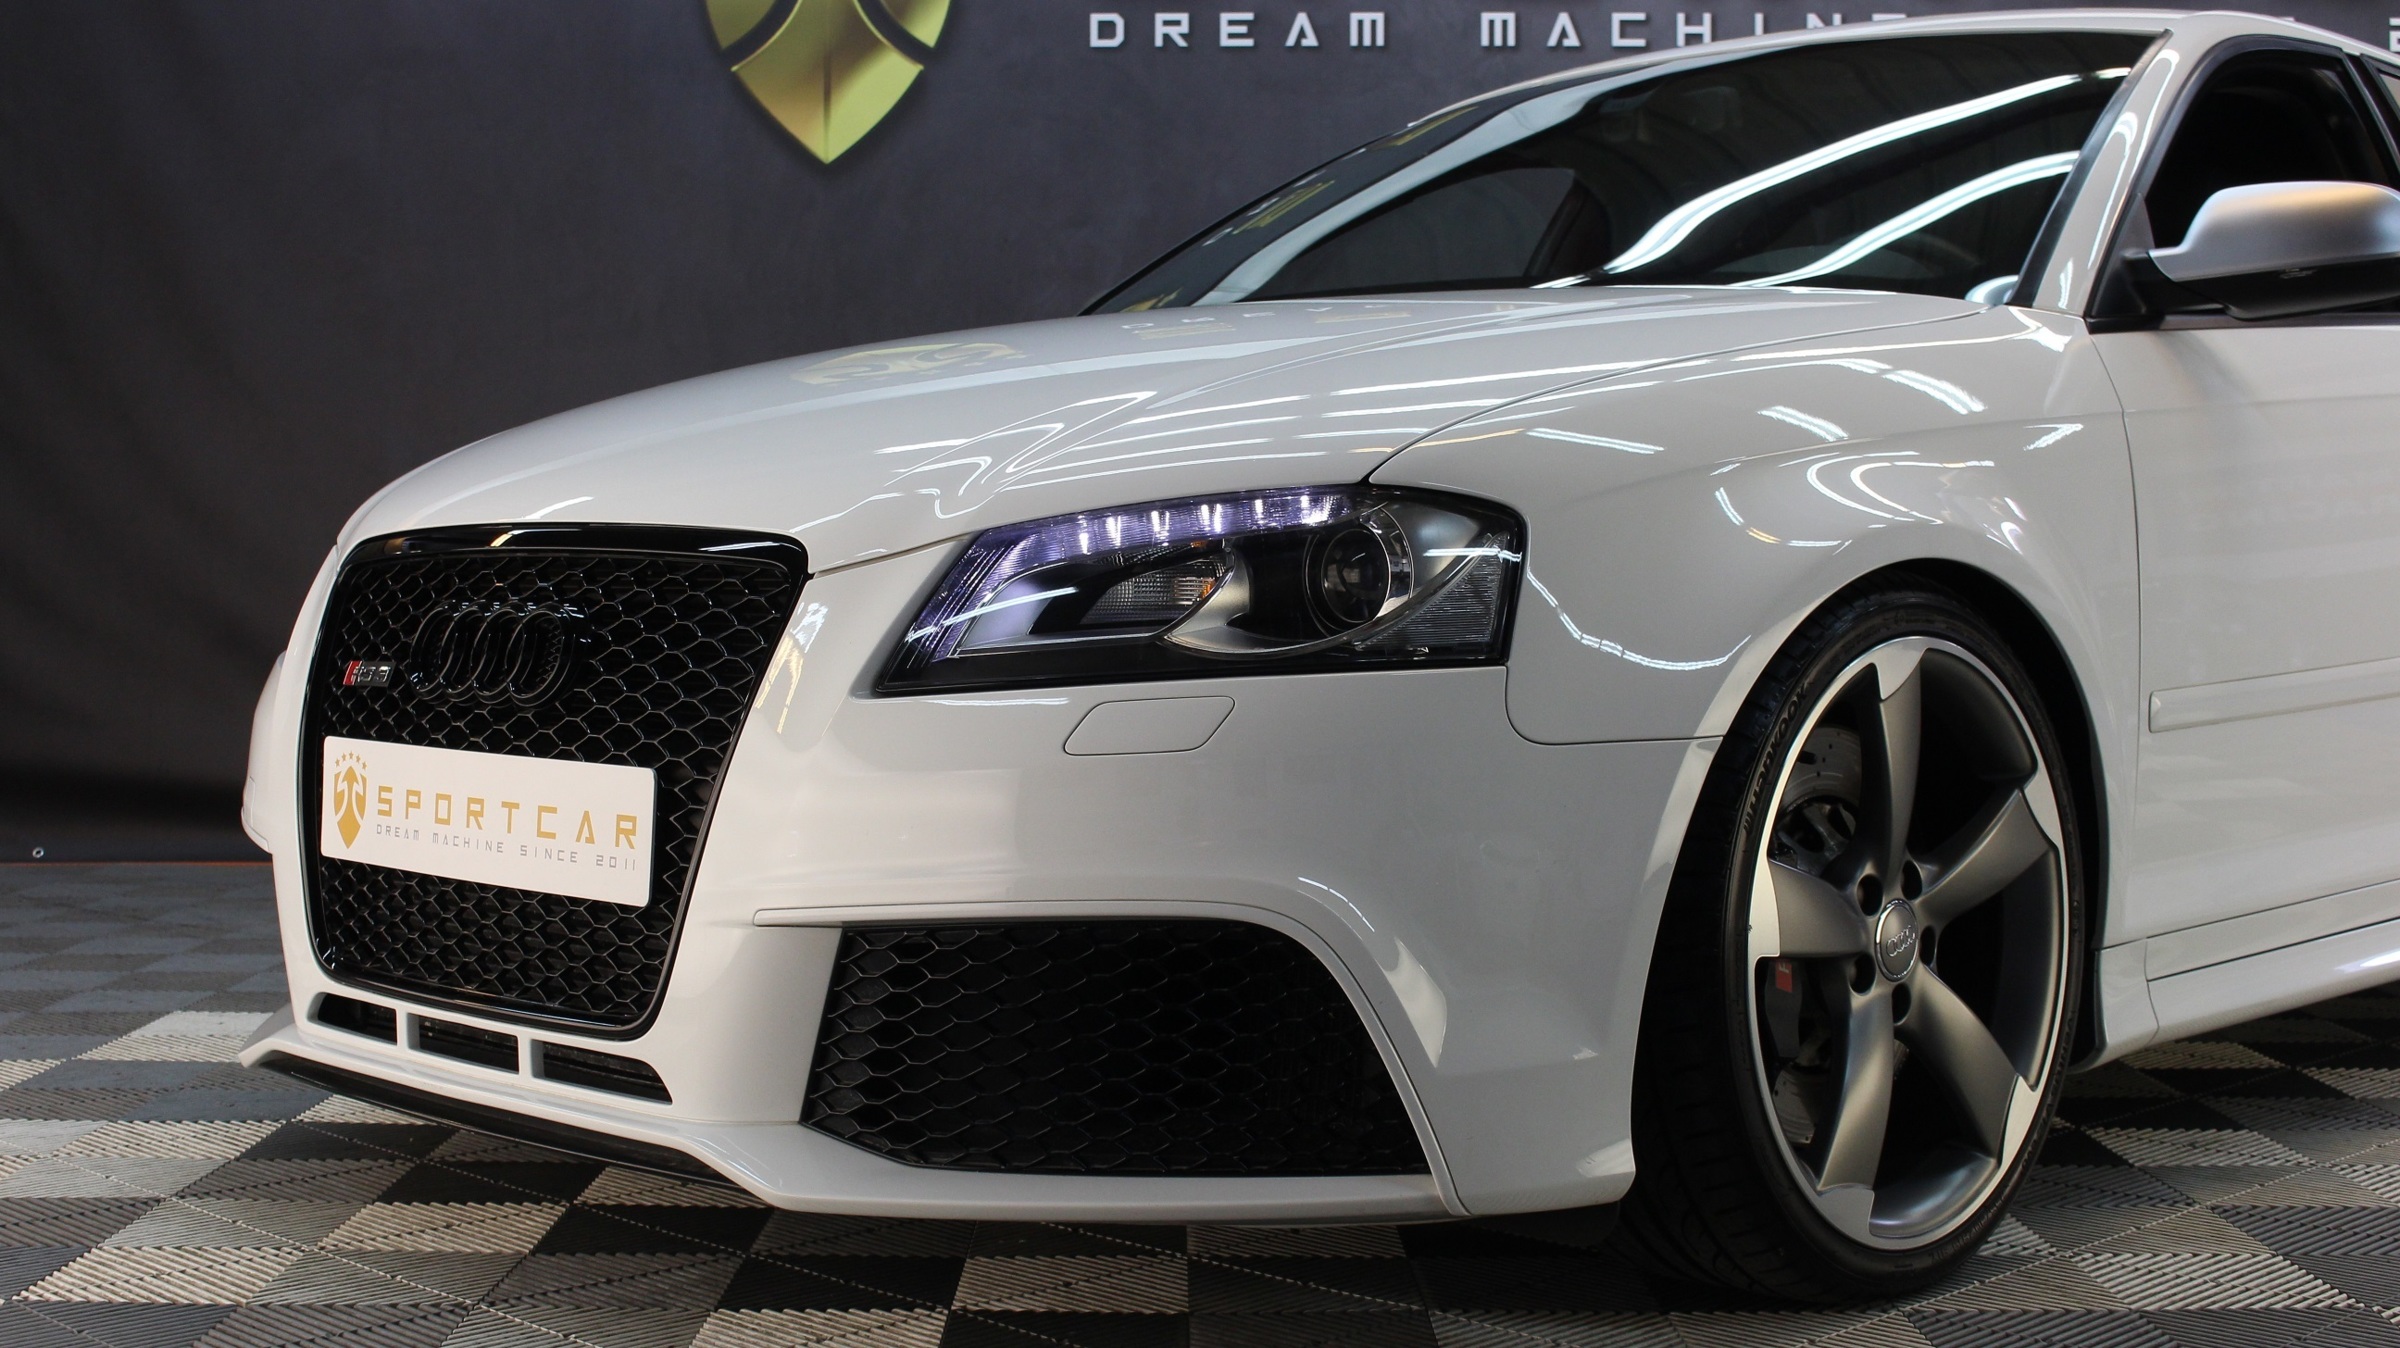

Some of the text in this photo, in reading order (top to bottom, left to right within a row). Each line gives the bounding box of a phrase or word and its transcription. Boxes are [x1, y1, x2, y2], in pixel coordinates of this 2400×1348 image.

[1089, 11, 1386, 48] DREAM
[377, 785, 638, 850] SPORTCAR
[376, 824, 636, 871] DREAM MACHINE SINCE 2011
